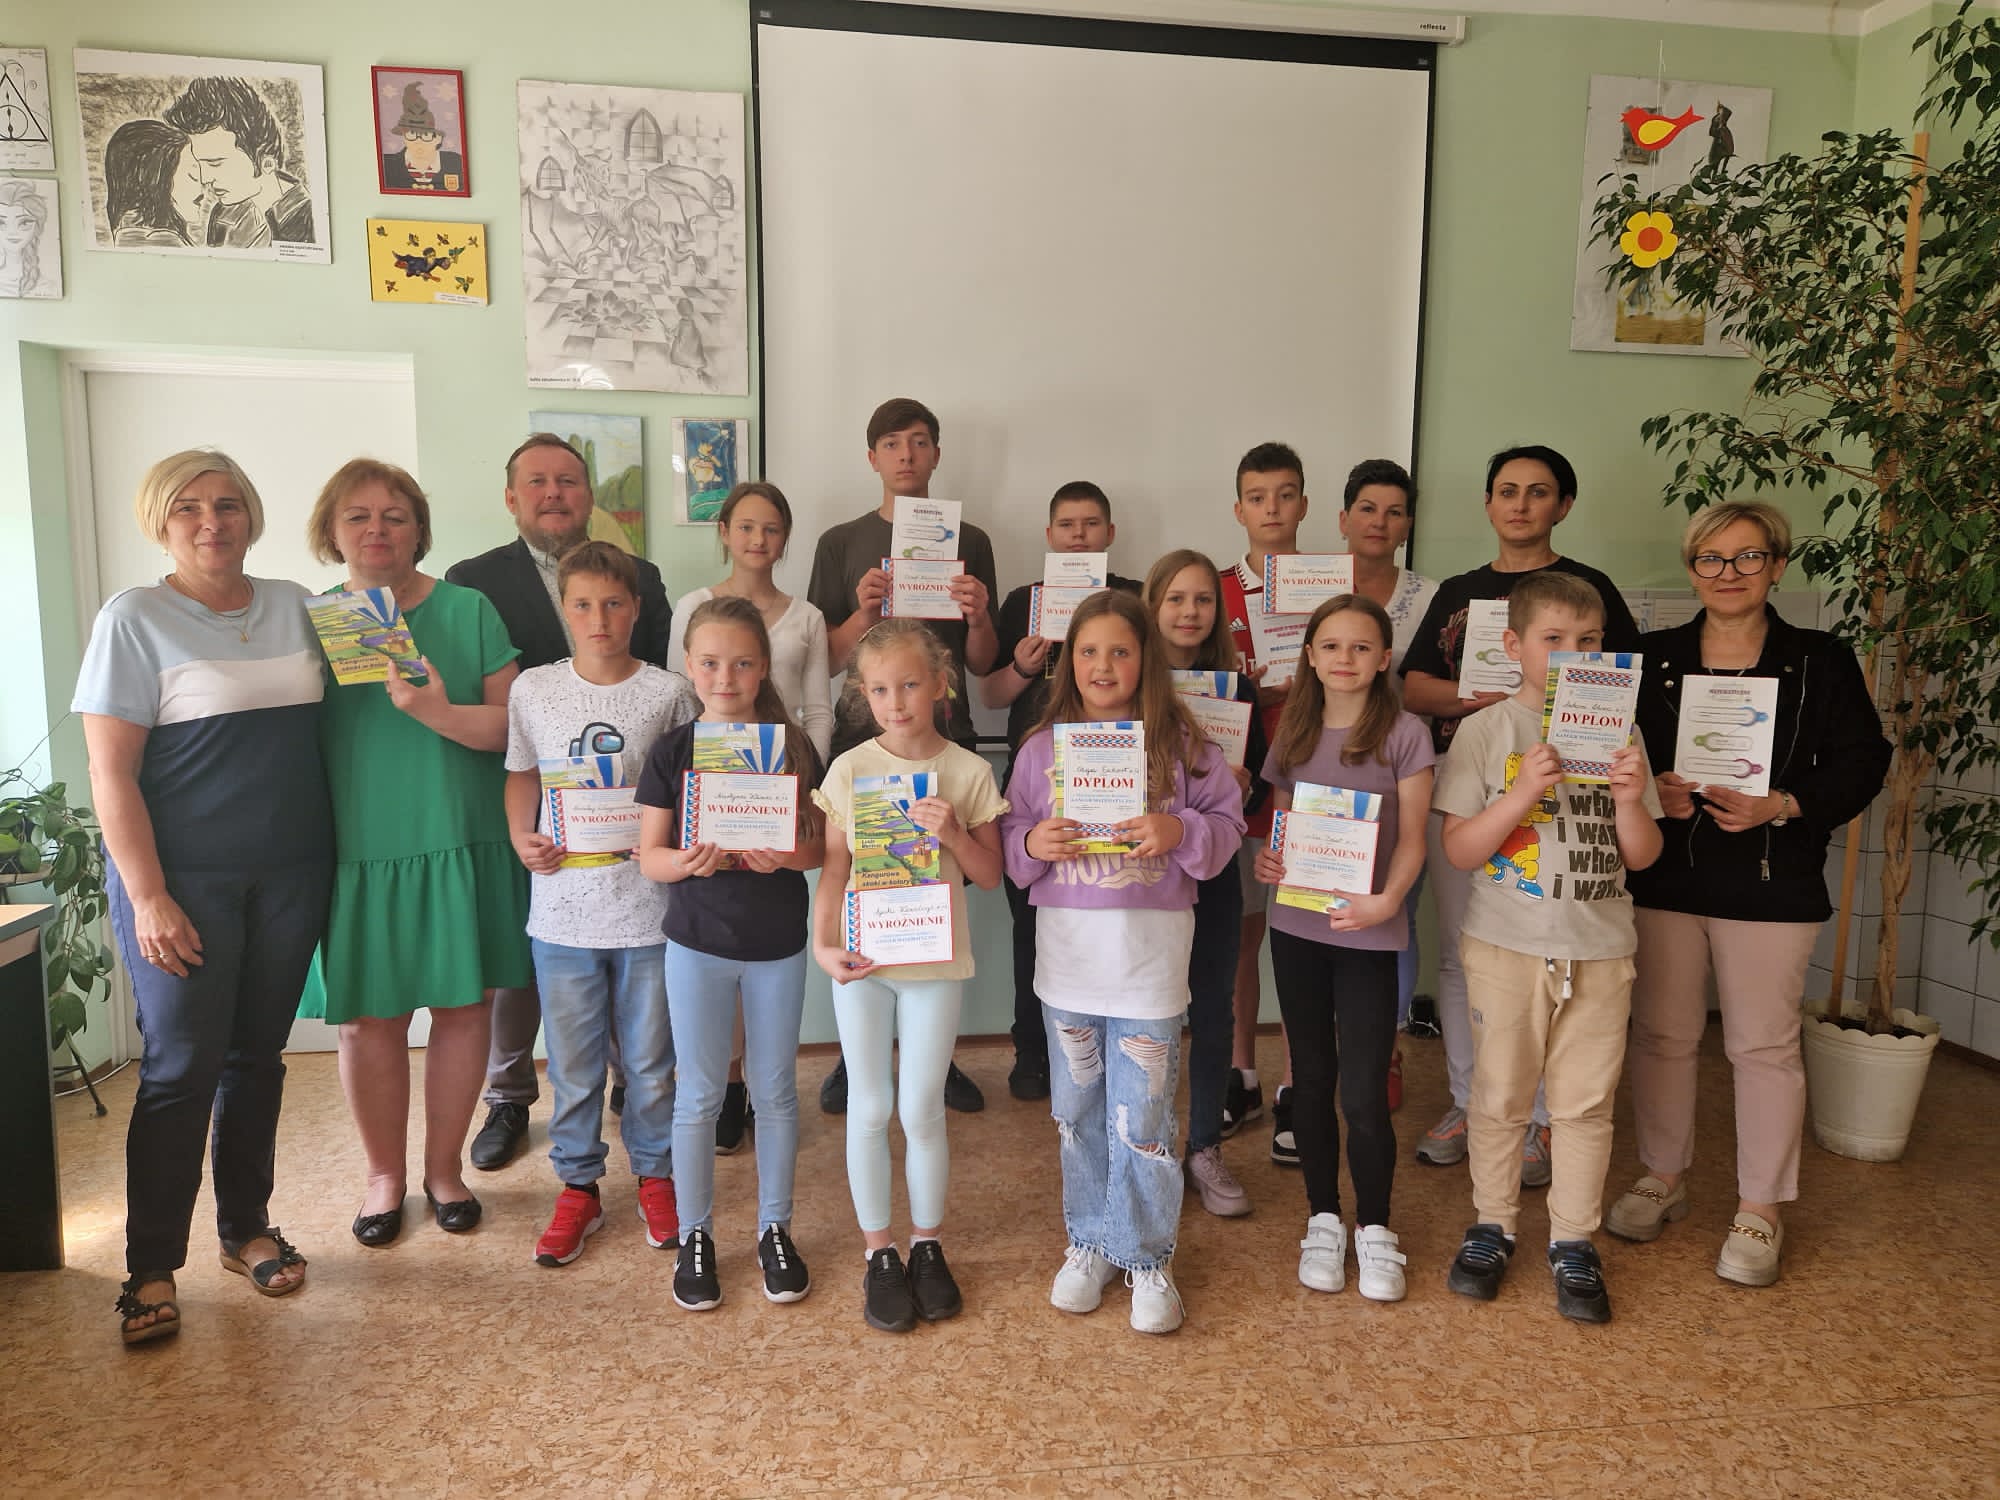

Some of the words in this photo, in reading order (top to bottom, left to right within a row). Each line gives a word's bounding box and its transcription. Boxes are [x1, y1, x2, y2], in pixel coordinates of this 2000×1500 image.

[898, 581, 952, 592] WYRÓŻNIEN
[1560, 712, 1625, 729] DYPLOM
[1201, 724, 1241, 737] ŻNIENIE
[1073, 776, 1134, 789] DYPLOM
[707, 802, 788, 816] WYRÓŻNIENIE
[1557, 816, 1566, 843] i
[1553, 872, 1563, 899] i
[868, 915, 945, 929] WYRÓŻNIENIE
